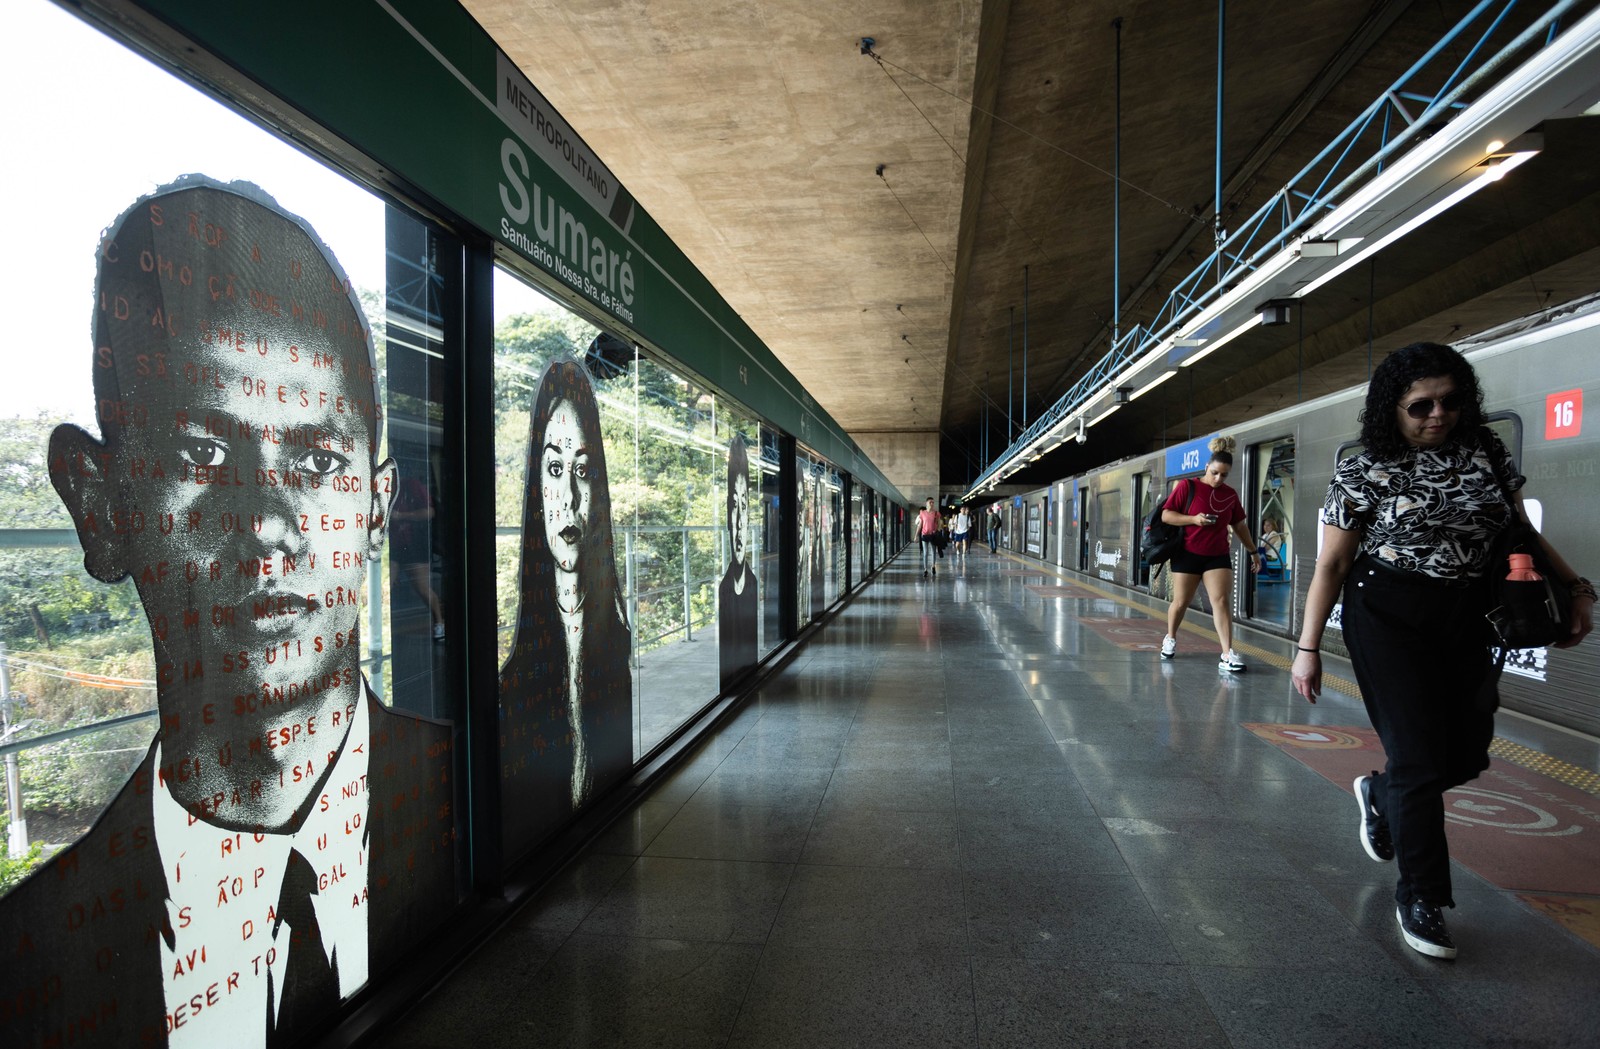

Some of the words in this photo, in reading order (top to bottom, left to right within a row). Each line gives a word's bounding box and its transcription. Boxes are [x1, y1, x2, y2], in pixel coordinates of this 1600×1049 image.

[506, 76, 608, 200] METROPOLITANO
[499, 138, 635, 306] Sumaré
[501, 217, 553, 268] Santuário
[555, 255, 583, 290] Nossa
[584, 277, 600, 301] Sra.
[601, 289, 611, 309] de
[611, 293, 634, 324] Fátima
[1181, 449, 1200, 471] J473
[1553, 400, 1574, 428] 16
